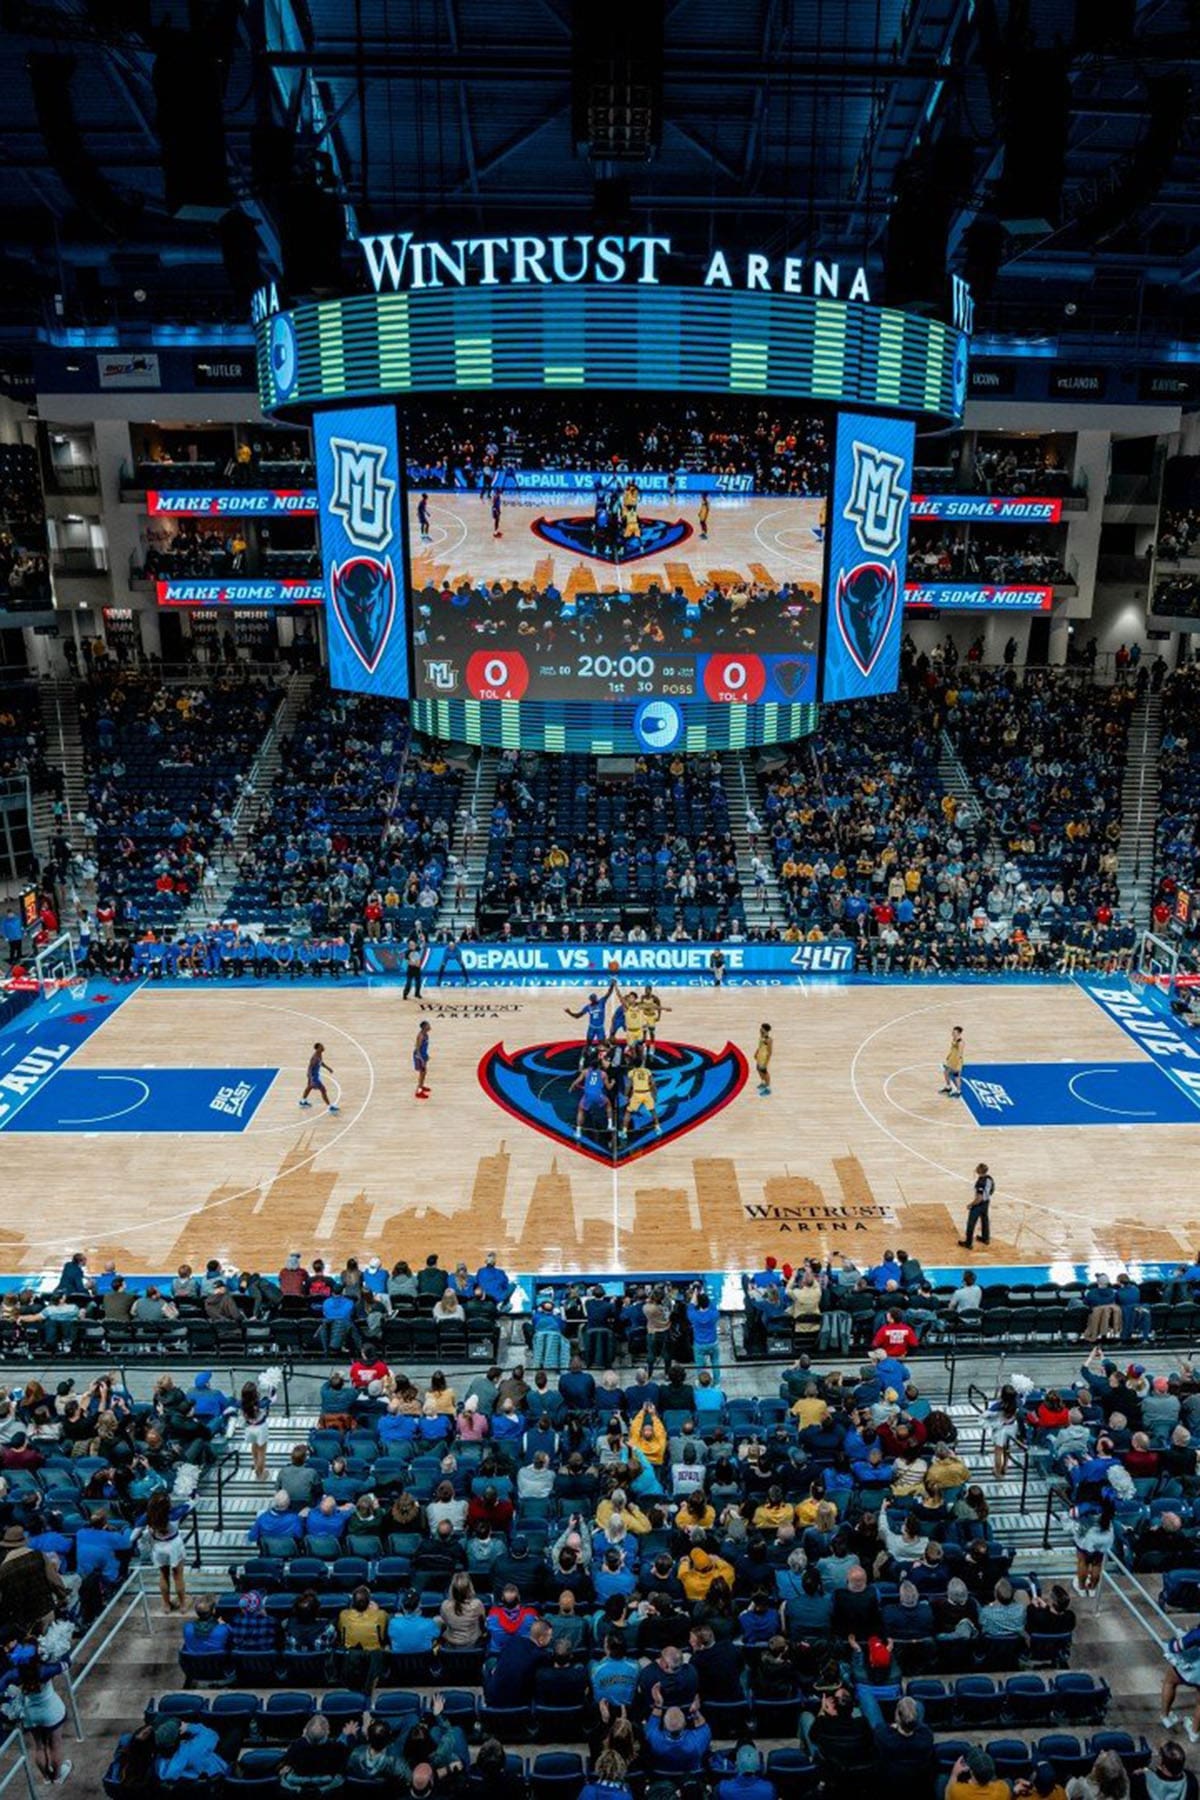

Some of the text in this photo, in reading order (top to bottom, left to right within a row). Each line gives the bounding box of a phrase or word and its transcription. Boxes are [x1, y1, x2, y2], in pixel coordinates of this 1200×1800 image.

[359, 231, 871, 301] WINTRUST ARENA
[156, 496, 320, 511] MAKE SOME NOIS
[329, 437, 396, 552] MU
[842, 440, 909, 557] MU
[945, 502, 996, 516] SOME
[998, 504, 1055, 518] NOISE
[165, 586, 326, 600] MAKE SOME NOIS
[939, 590, 990, 604] SOME
[992, 591, 1046, 605] NOISE
[423, 659, 460, 692] MU
[484, 659, 509, 687] 0
[577, 655, 656, 679] 20:00
[722, 662, 747, 690] 0
[480, 690, 512, 700] TOL 4
[608, 682, 625, 693] 1st
[637, 682, 654, 693] 30
[662, 684, 694, 694] POSS
[718, 691, 749, 702] TOL 4
[462, 949, 549, 969] DePAUL
[1088, 986, 1200, 1060] BLUE
[209, 1086, 234, 1111] BIG
[223, 1080, 251, 1115] EAST
[745, 1204, 891, 1218] WINTRUST
[780, 1221, 868, 1233] ARENA
